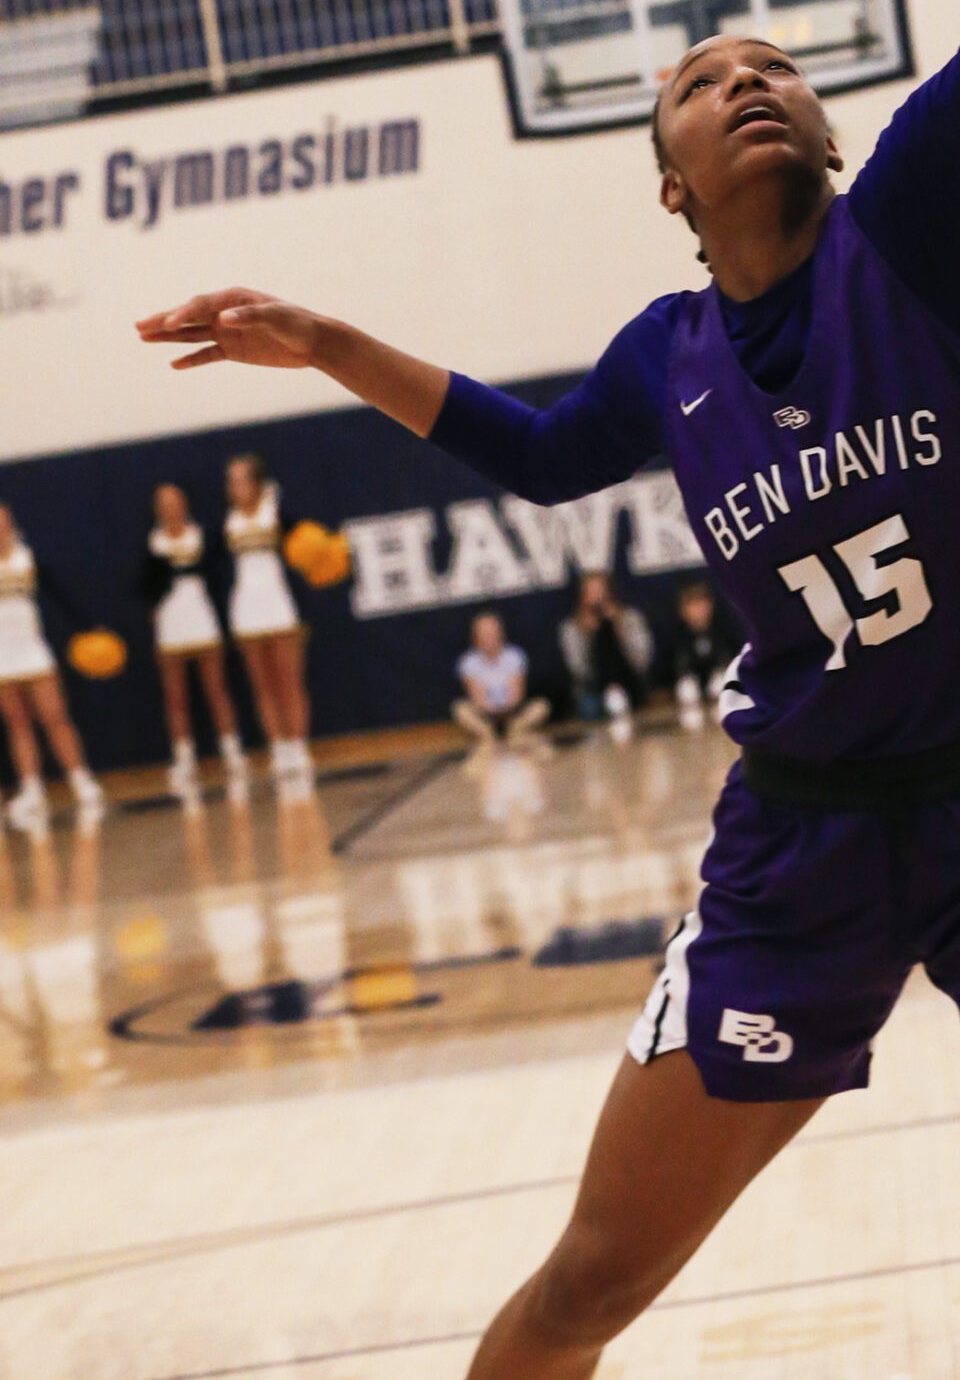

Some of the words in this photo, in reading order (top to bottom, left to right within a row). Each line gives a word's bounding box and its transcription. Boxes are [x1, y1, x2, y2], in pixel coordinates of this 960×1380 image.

[104, 115, 423, 231] Gymnasium
[703, 464, 791, 562] BEN
[799, 408, 943, 501] DAVIS
[777, 512, 934, 672] 15
